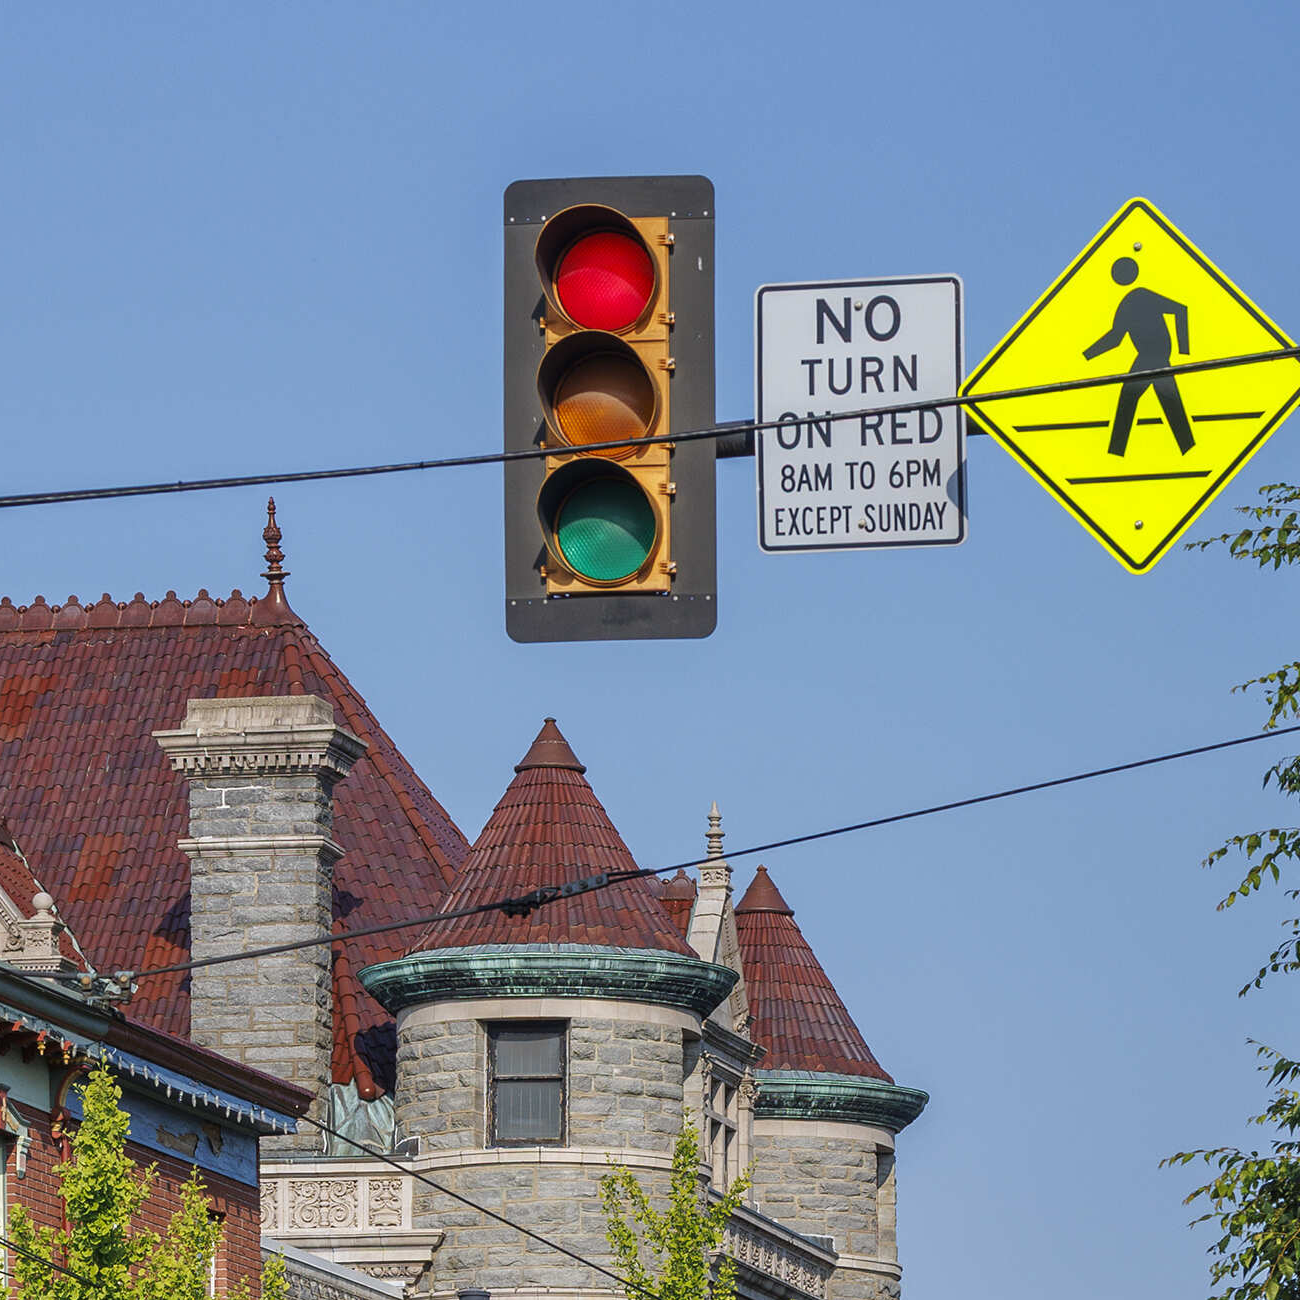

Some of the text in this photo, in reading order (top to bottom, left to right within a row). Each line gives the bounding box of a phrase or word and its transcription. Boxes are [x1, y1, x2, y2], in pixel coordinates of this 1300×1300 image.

[816, 295, 901, 344] NO
[801, 354, 917, 396] TURN
[777, 406, 943, 449] ON RED
[781, 459, 941, 493] 8AM TO 6PM
[775, 502, 948, 536] EXCEPT SUNDAY
